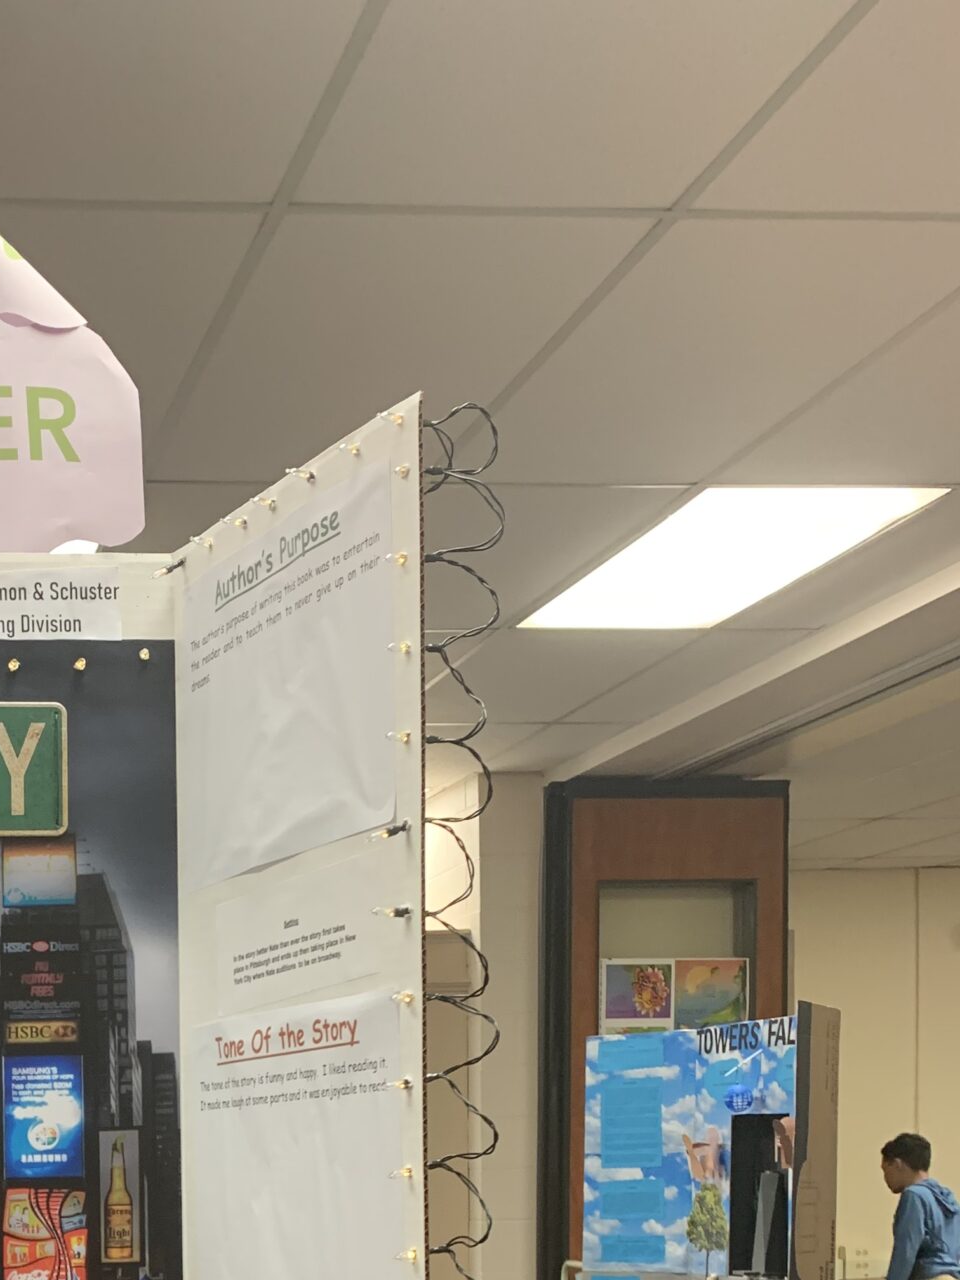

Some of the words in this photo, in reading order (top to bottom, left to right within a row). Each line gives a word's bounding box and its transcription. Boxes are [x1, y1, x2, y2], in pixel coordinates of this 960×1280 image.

[215, 550, 273, 604] Author's
[280, 510, 340, 564] Purpose
[343, 533, 380, 560] entertain
[33, 582, 44, 601] &
[49, 581, 120, 601] Schuster
[20, 614, 82, 633] Division
[7, 1025, 52, 1040] HSBC
[215, 1037, 244, 1059] Tone
[251, 1027, 271, 1053] Of
[279, 1023, 304, 1049] the
[312, 1019, 357, 1047] Story
[697, 1022, 761, 1055] TOWERS
[21, 1154, 67, 1163] SAMSUNG
